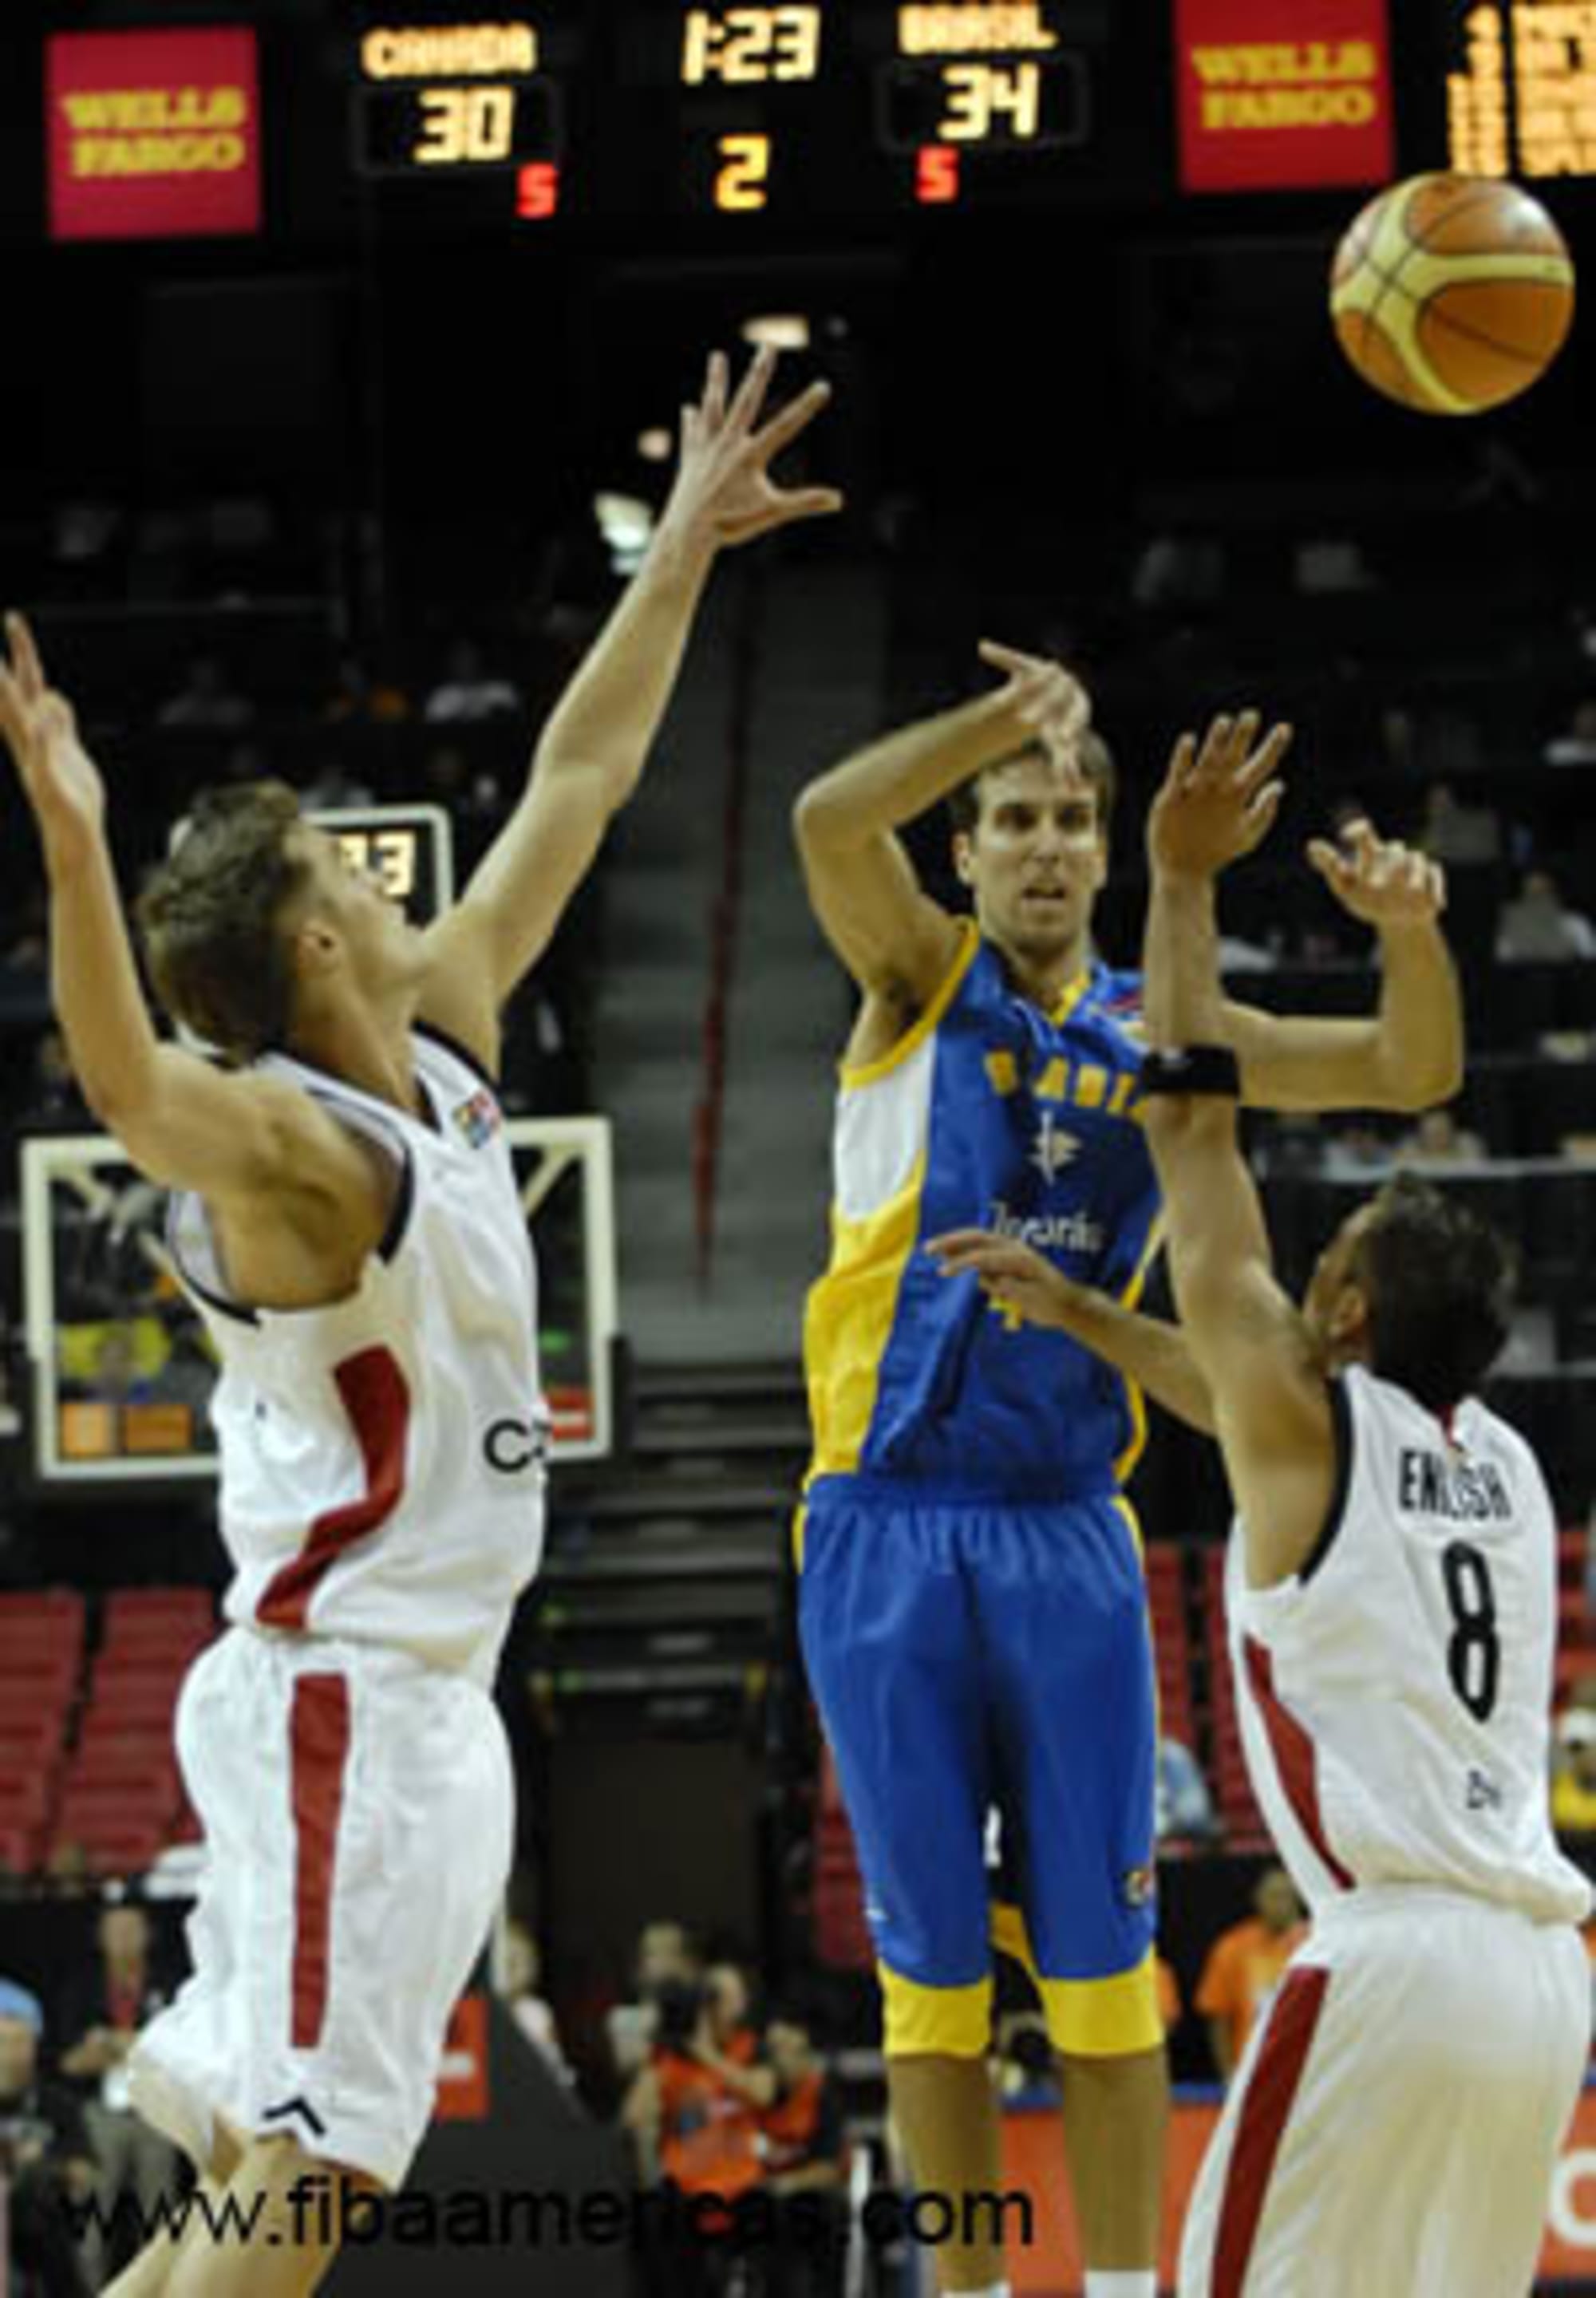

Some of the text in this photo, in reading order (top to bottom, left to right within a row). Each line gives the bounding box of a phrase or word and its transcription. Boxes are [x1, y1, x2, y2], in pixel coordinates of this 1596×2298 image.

[682, 6, 820, 83] 1:23
[1192, 43, 1374, 83] WELLS
[62, 87, 245, 128] WELLS
[415, 86, 515, 162] 30
[938, 63, 1039, 140] 34
[1203, 85, 1374, 128] FARGO
[71, 132, 244, 177] FARGO
[715, 133, 769, 211] 2
[915, 144, 958, 203] 5
[516, 163, 557, 219] 5
[1441, 1540, 1501, 1724] 8
